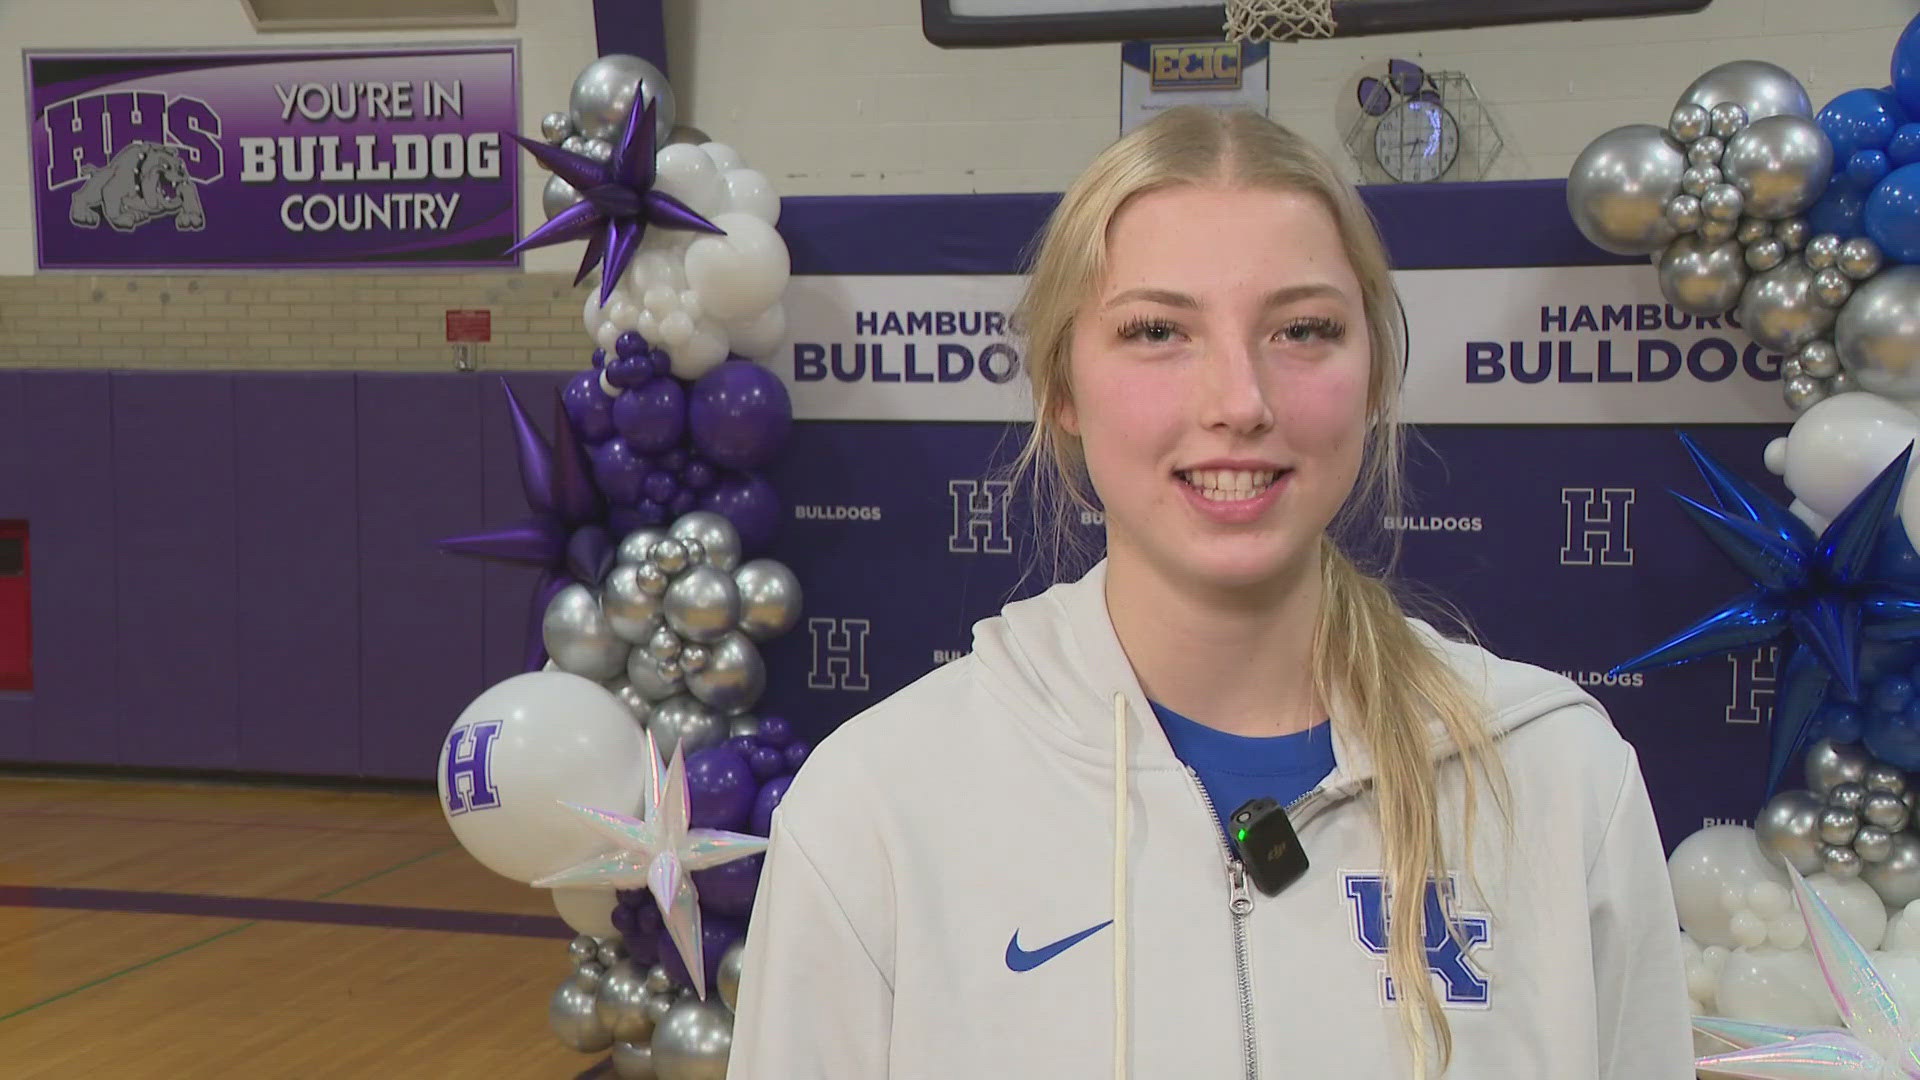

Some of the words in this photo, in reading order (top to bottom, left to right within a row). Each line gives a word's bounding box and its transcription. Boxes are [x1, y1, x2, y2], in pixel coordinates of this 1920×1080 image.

[274, 81, 413, 120] YOU'RE
[423, 79, 461, 117] IN
[44, 89, 223, 190] HHS
[239, 132, 501, 182] BULLDOG
[280, 192, 460, 232] COUNTRY
[795, 343, 1030, 385] BULLDO
[795, 505, 881, 521] BULLDOGS
[949, 480, 1013, 554] H
[1384, 516, 1483, 531] BULLDOGS
[1560, 488, 1636, 565] H
[808, 618, 870, 691] H
[445, 720, 503, 816] H
